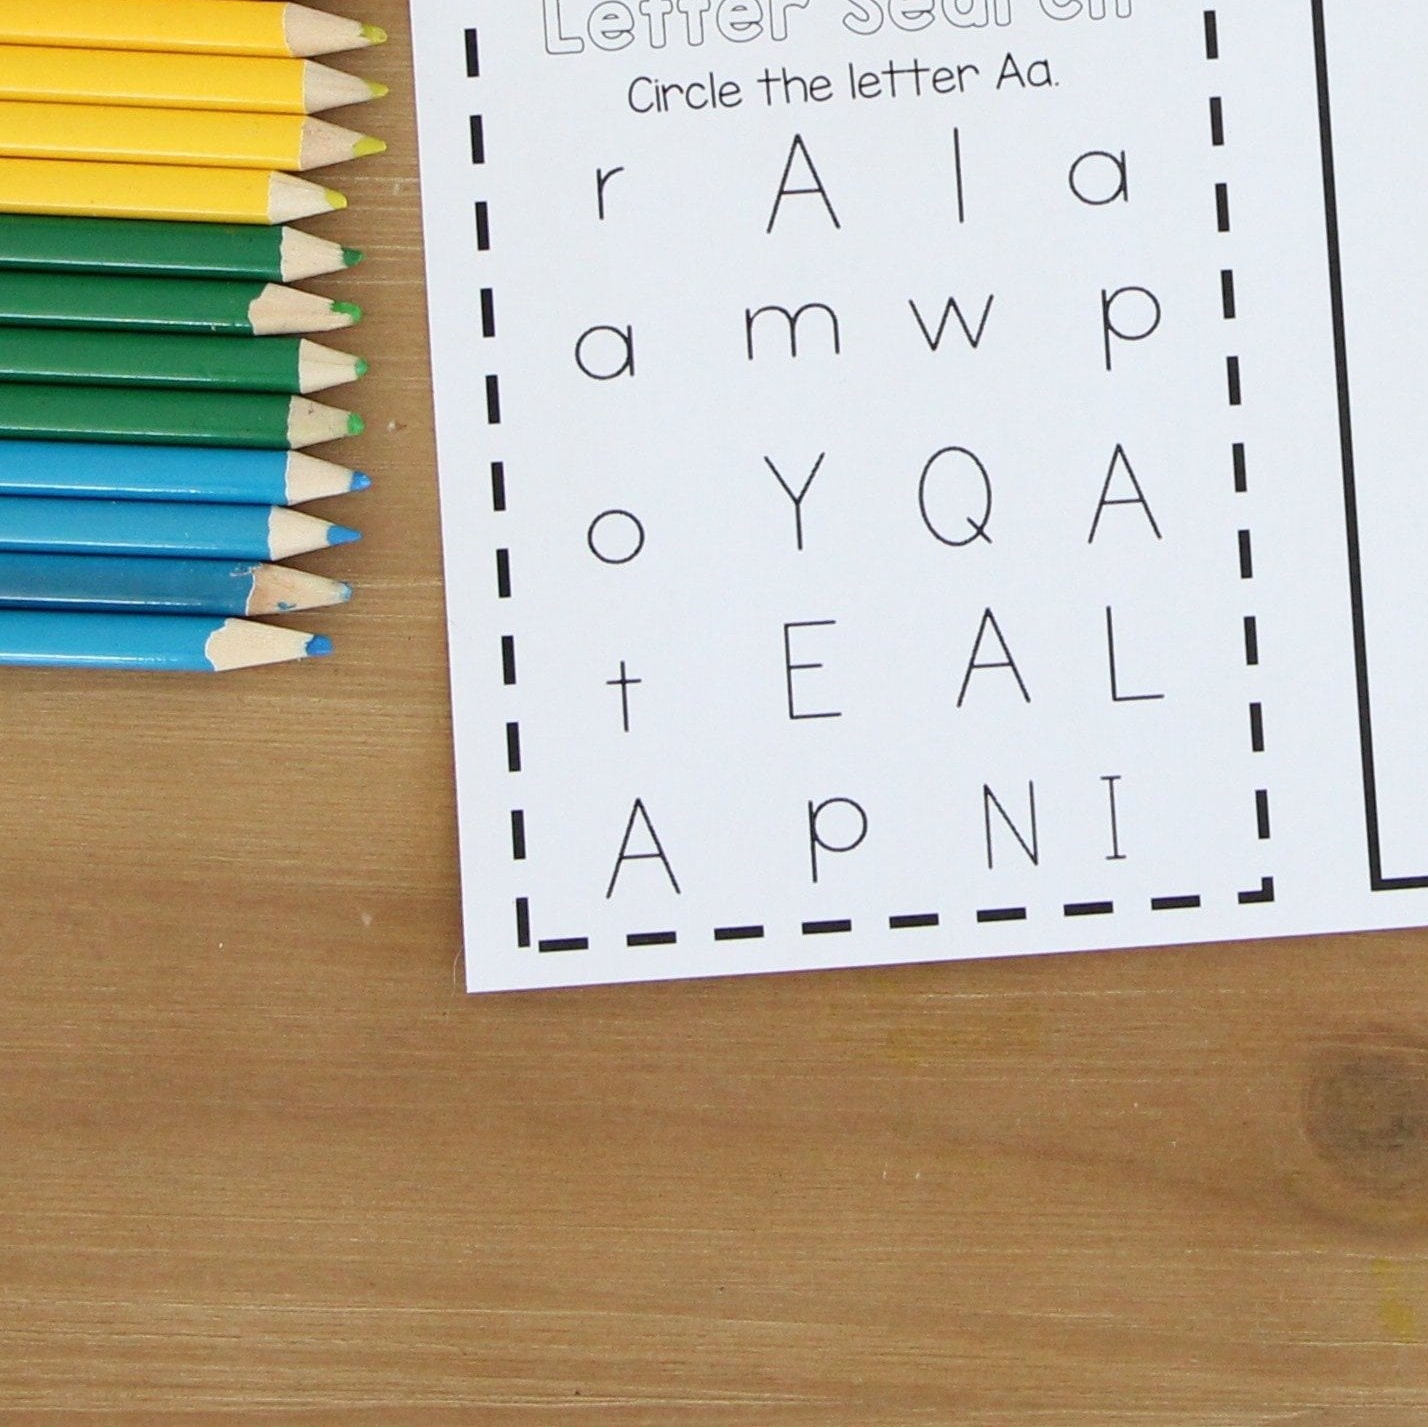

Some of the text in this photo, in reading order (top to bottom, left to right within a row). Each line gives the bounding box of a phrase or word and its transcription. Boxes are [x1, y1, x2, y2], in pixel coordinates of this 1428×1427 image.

[628, 51, 1060, 115] Circle the letter Aa.
[596, 165, 625, 221] r
[766, 132, 842, 235] A
[1068, 149, 1129, 207] a
[575, 285, 1162, 382] a m w p
[587, 442, 1163, 566] o Y Q A
[606, 604, 1166, 734] t E A L
[606, 774, 1128, 900] A p N I
